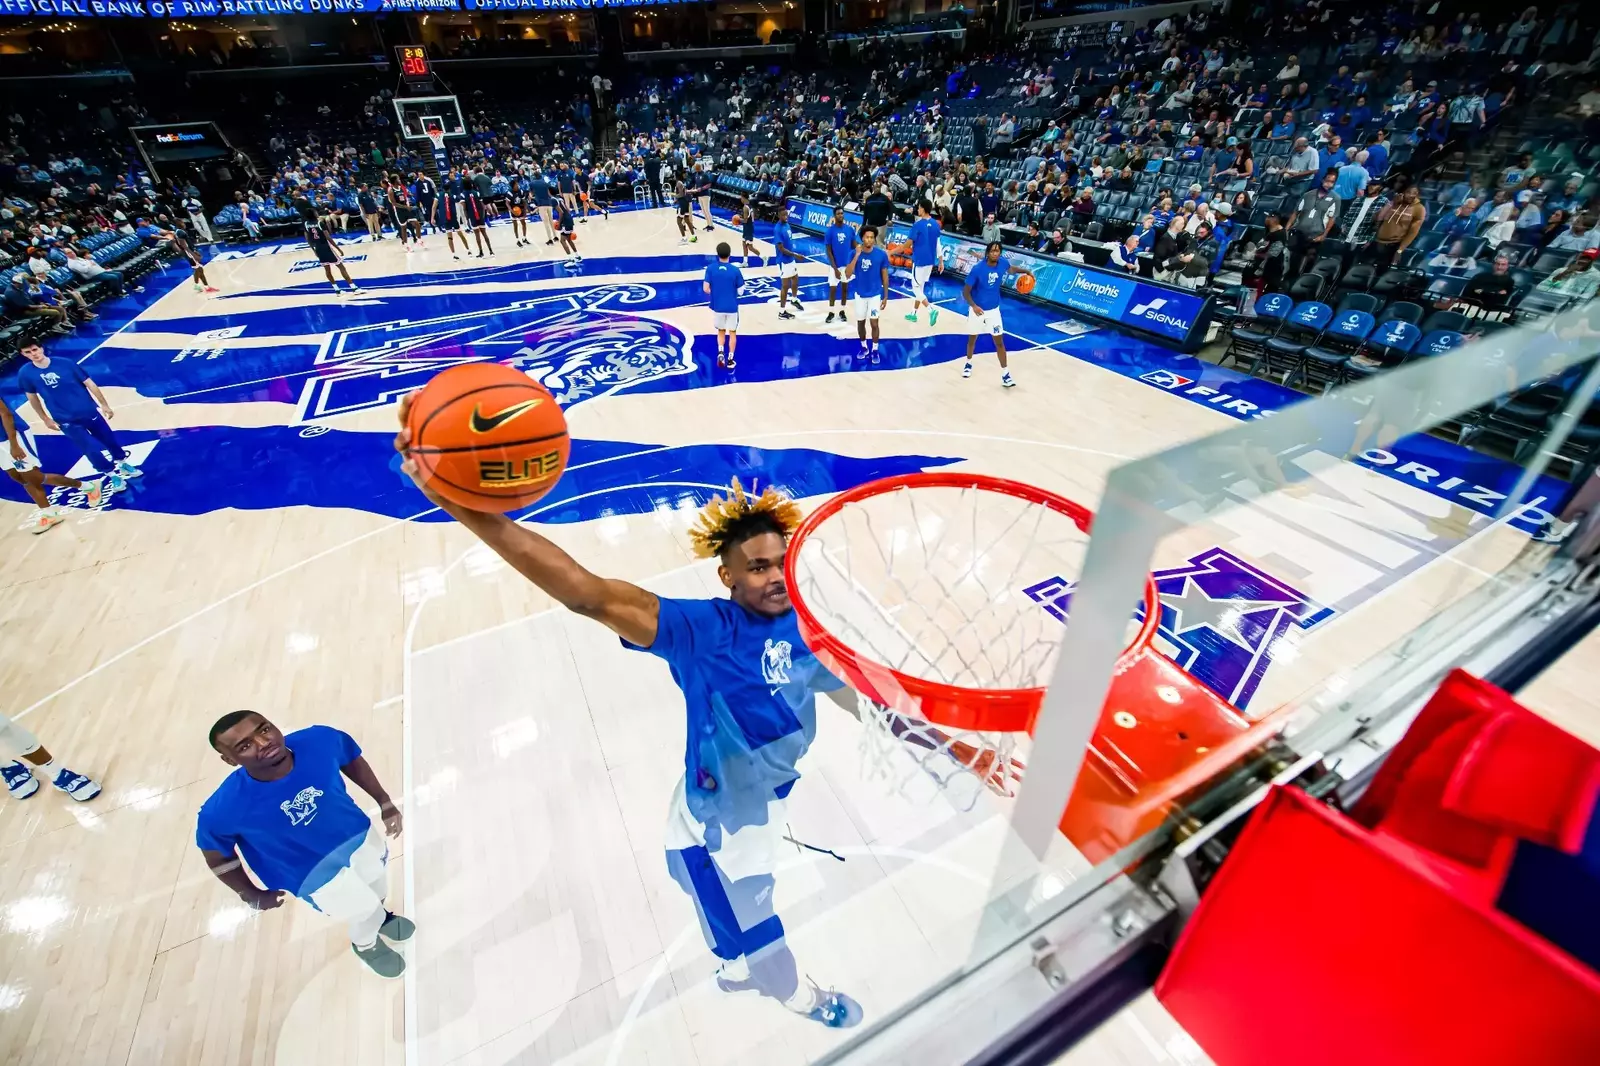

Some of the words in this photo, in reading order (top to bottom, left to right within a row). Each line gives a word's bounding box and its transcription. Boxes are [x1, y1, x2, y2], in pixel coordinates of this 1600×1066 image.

[0, 0, 86, 13] FFICIAL
[92, 1, 147, 14] BANK
[152, 2, 175, 14] OF
[183, 0, 304, 13] RIM-RATTLING
[311, 0, 365, 10] DUNKS
[391, 0, 415, 8] FIRST
[807, 211, 827, 226] YOUR
[1075, 276, 1120, 298] Memphis
[1145, 310, 1189, 330] SIGNAL
[479, 450, 560, 481] ELITE
